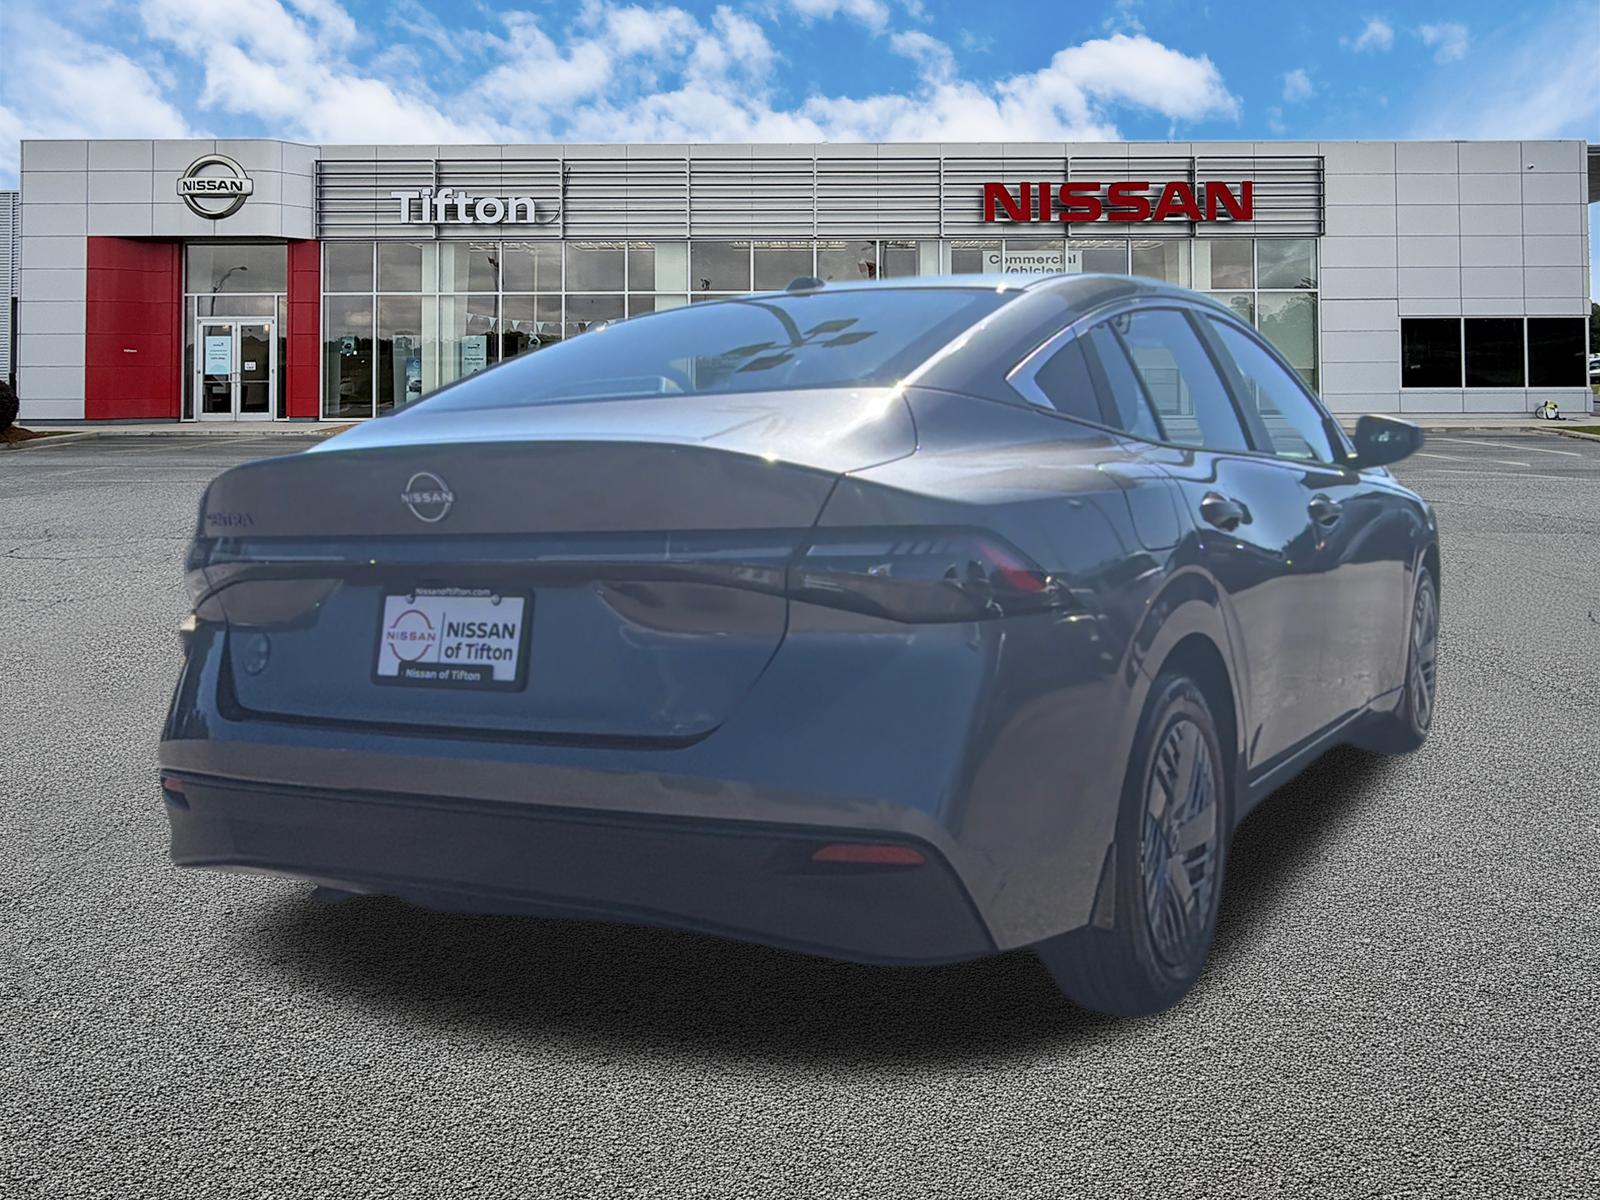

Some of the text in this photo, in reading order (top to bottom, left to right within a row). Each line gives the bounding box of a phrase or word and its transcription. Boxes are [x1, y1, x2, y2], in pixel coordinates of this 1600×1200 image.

[182, 180, 243, 191] NISSAN
[391, 188, 536, 224] Tifton
[984, 181, 1254, 222] NISSAN
[400, 491, 453, 503] NISSAN
[386, 631, 436, 642] NISSAN
[446, 621, 516, 640] NISSAN
[444, 642, 513, 661] of Tifton
[405, 668, 481, 681] Nissan of Tifton
